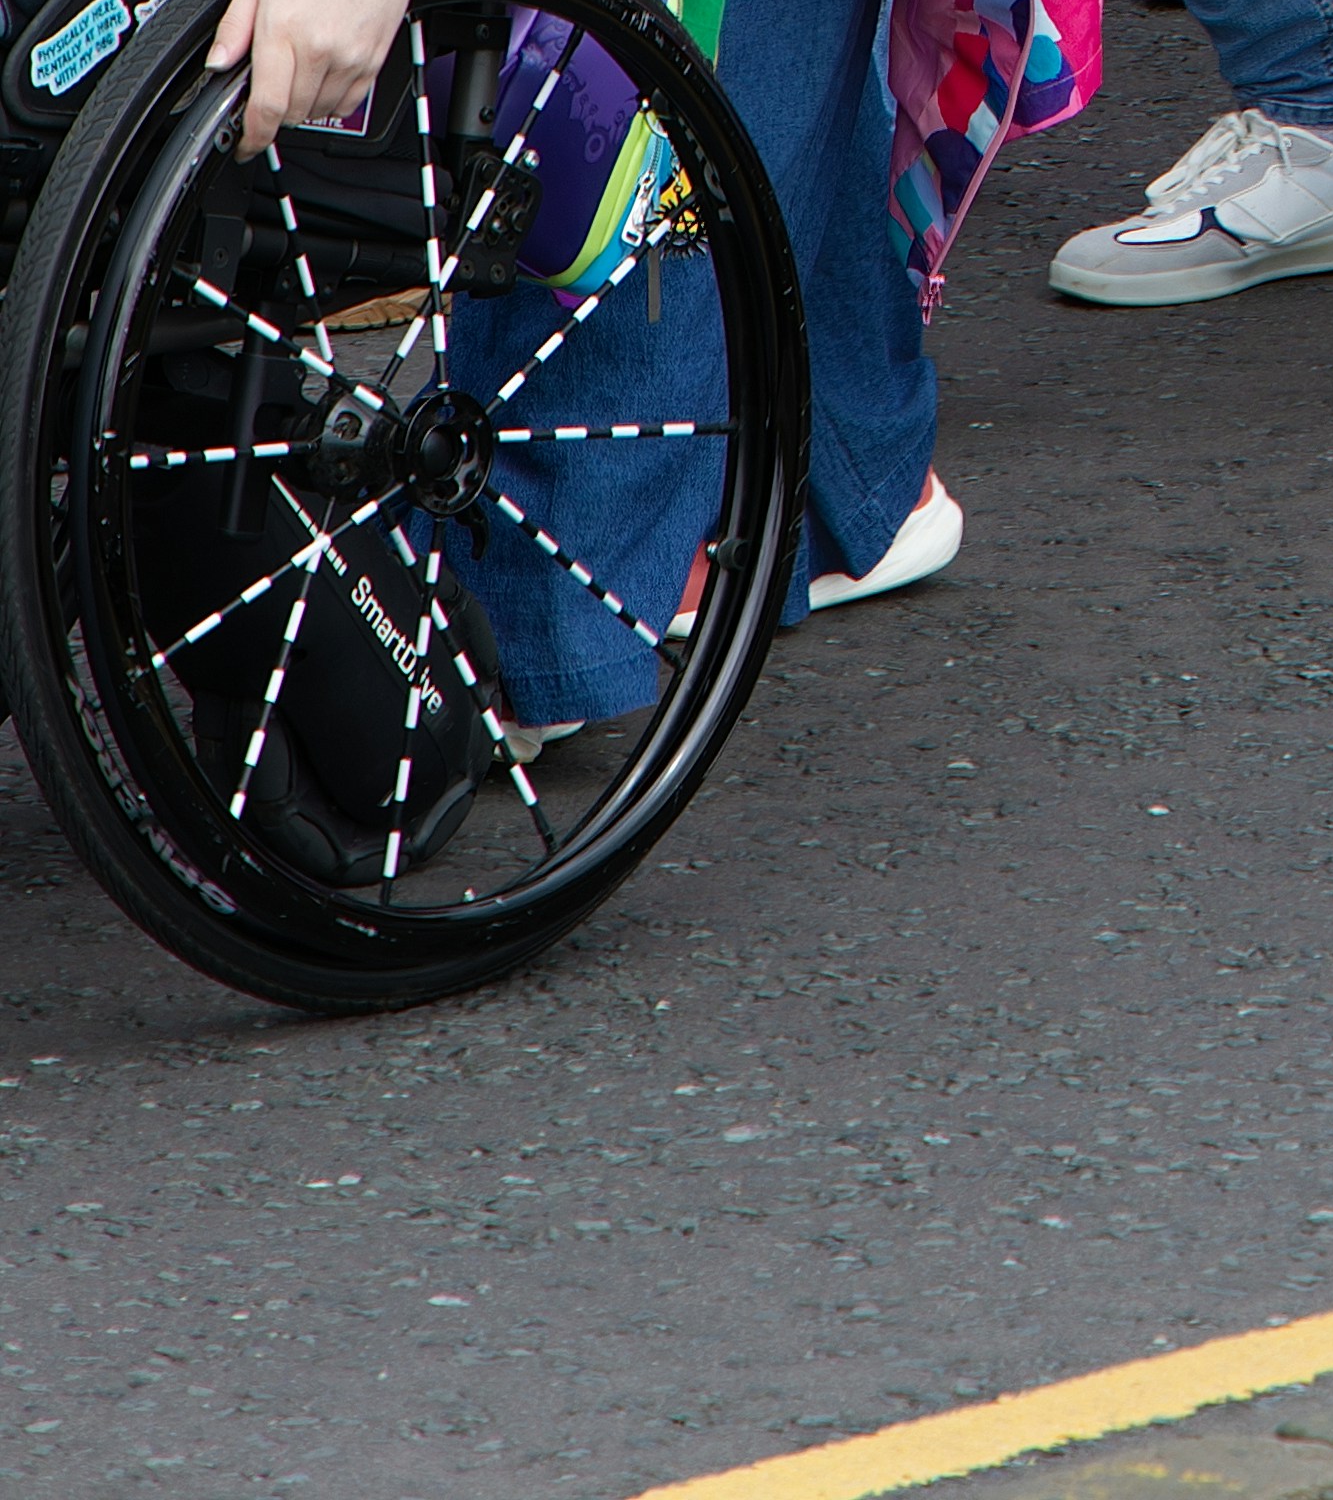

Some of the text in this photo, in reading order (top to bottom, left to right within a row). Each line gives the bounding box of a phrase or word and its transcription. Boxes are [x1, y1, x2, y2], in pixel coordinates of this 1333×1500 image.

[37, 15, 90, 63] PHYSICALLY
[37, 40, 82, 81] MENTALLY
[85, 28, 95, 46] AT
[54, 64, 78, 88] WITH
[79, 48, 93, 69] MY
[351, 573, 444, 715] SmartDive
